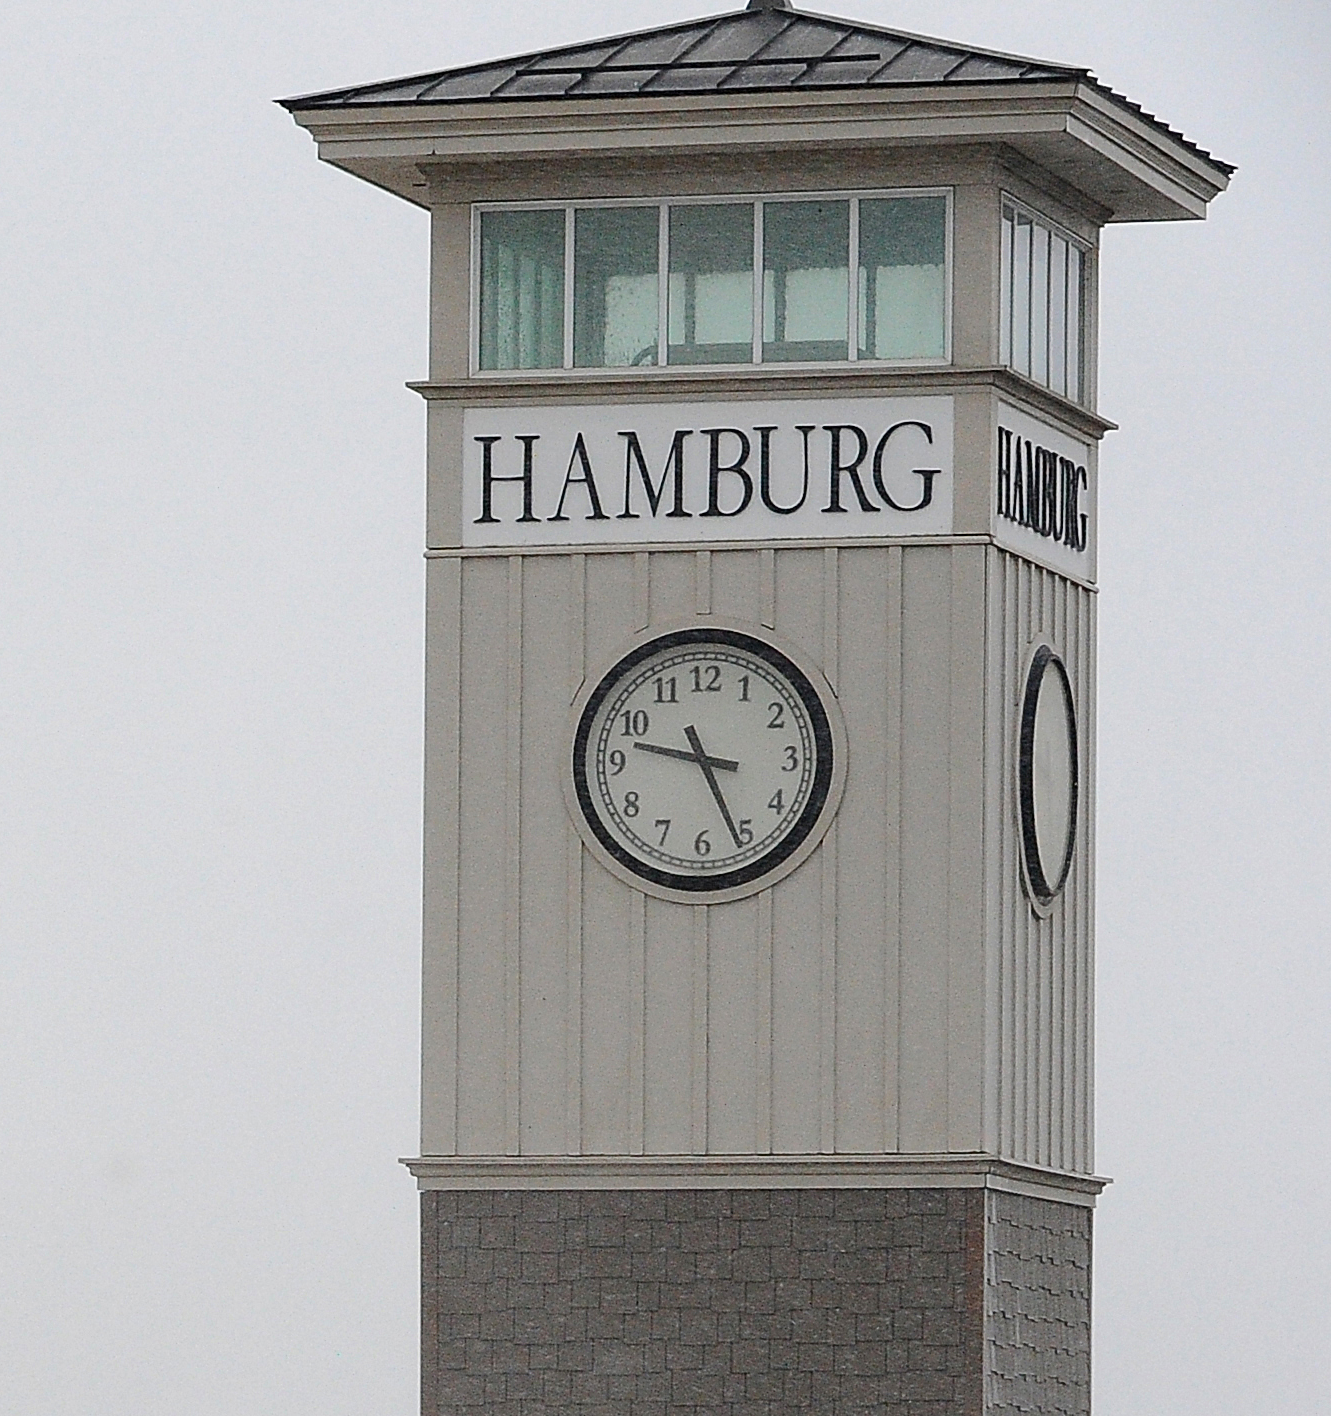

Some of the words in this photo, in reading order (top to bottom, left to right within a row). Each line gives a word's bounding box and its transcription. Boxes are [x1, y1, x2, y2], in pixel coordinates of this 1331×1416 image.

[473, 420, 942, 524] HAMBURG
[997, 426, 1088, 552] HAMBURG
[652, 676, 679, 703] 11
[690, 665, 722, 692] 12
[738, 675, 751, 702] 1
[619, 709, 649, 736] 10
[767, 702, 785, 729] 2
[610, 750, 626, 776] 9
[782, 746, 798, 772] 3
[623, 792, 639, 817] 8
[768, 789, 785, 815] 4
[655, 820, 671, 846] 7
[695, 830, 711, 856] 6
[739, 819, 754, 845] 5
